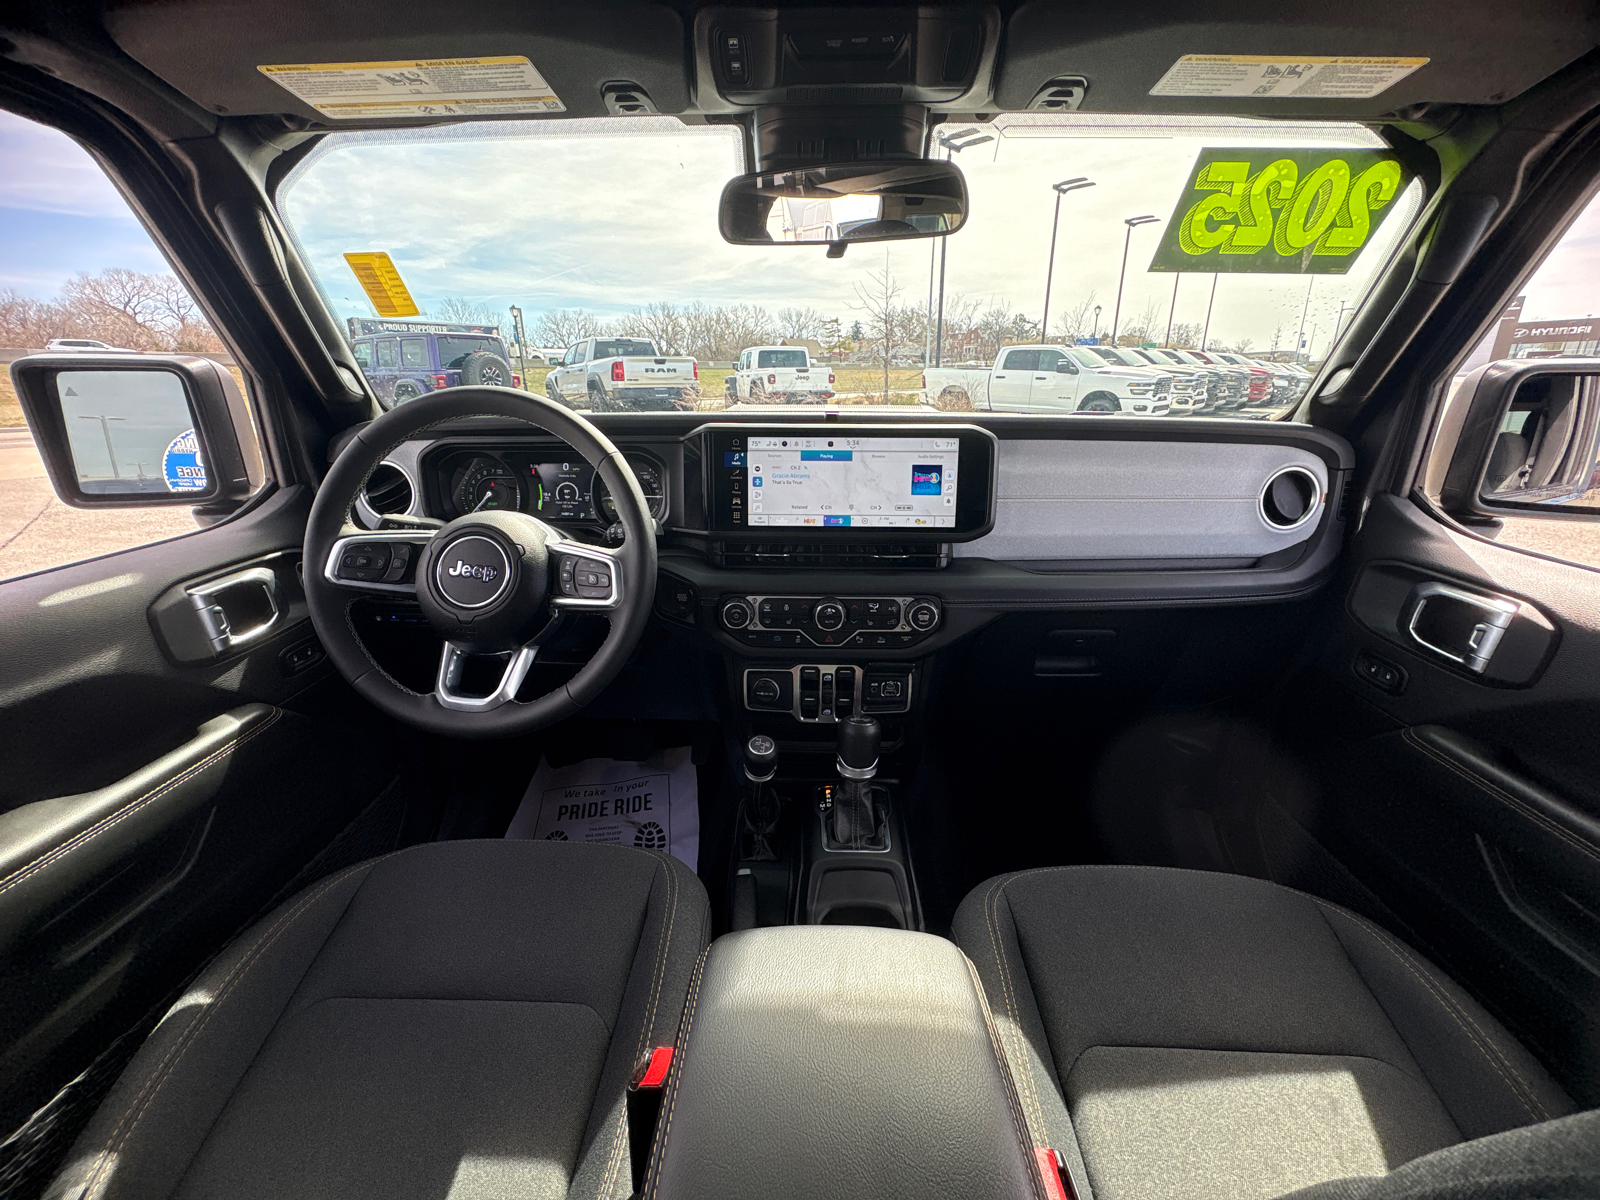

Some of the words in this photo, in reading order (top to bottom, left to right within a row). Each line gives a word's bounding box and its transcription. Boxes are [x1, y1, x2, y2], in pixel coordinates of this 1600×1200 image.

[383, 323, 408, 332] PROUD
[409, 324, 447, 333] SUPPORTER
[1531, 325, 1592, 336] HYUNDAI
[562, 462, 569, 471] 0
[448, 560, 497, 582] Jeep
[564, 789, 581, 799] We
[583, 788, 606, 798] take
[613, 785, 623, 793] in
[626, 780, 649, 793] your
[557, 800, 609, 821] PRIDE
[614, 793, 653, 816] RIDE
